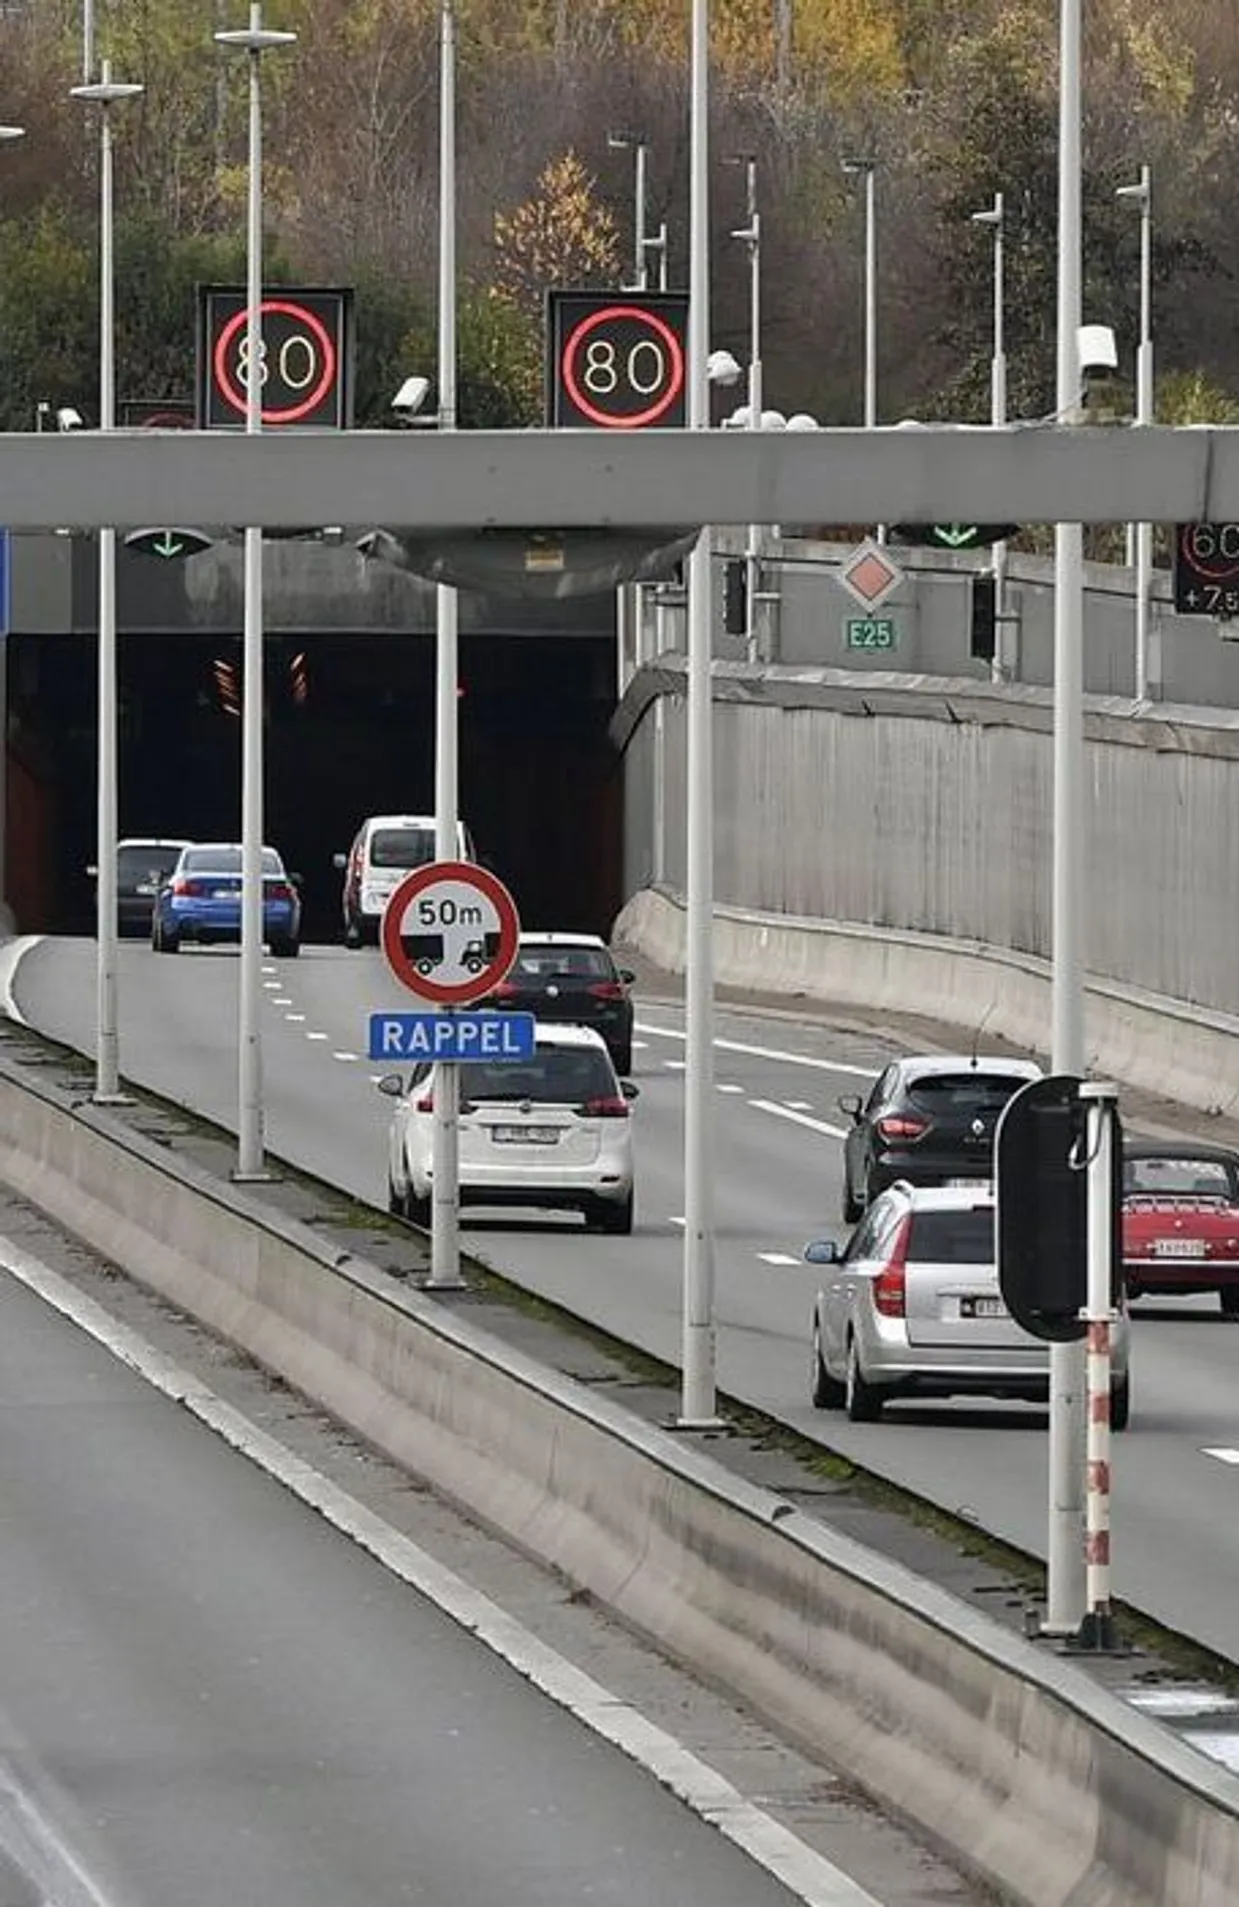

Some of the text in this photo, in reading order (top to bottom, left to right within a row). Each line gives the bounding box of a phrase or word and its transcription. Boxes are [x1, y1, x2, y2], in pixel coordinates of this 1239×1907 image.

[236, 335, 315, 388] 80
[584, 341, 664, 393] 80
[850, 622, 890, 646] E25
[418, 900, 482, 925] 50m
[382, 1021, 521, 1053] RAPPEL
